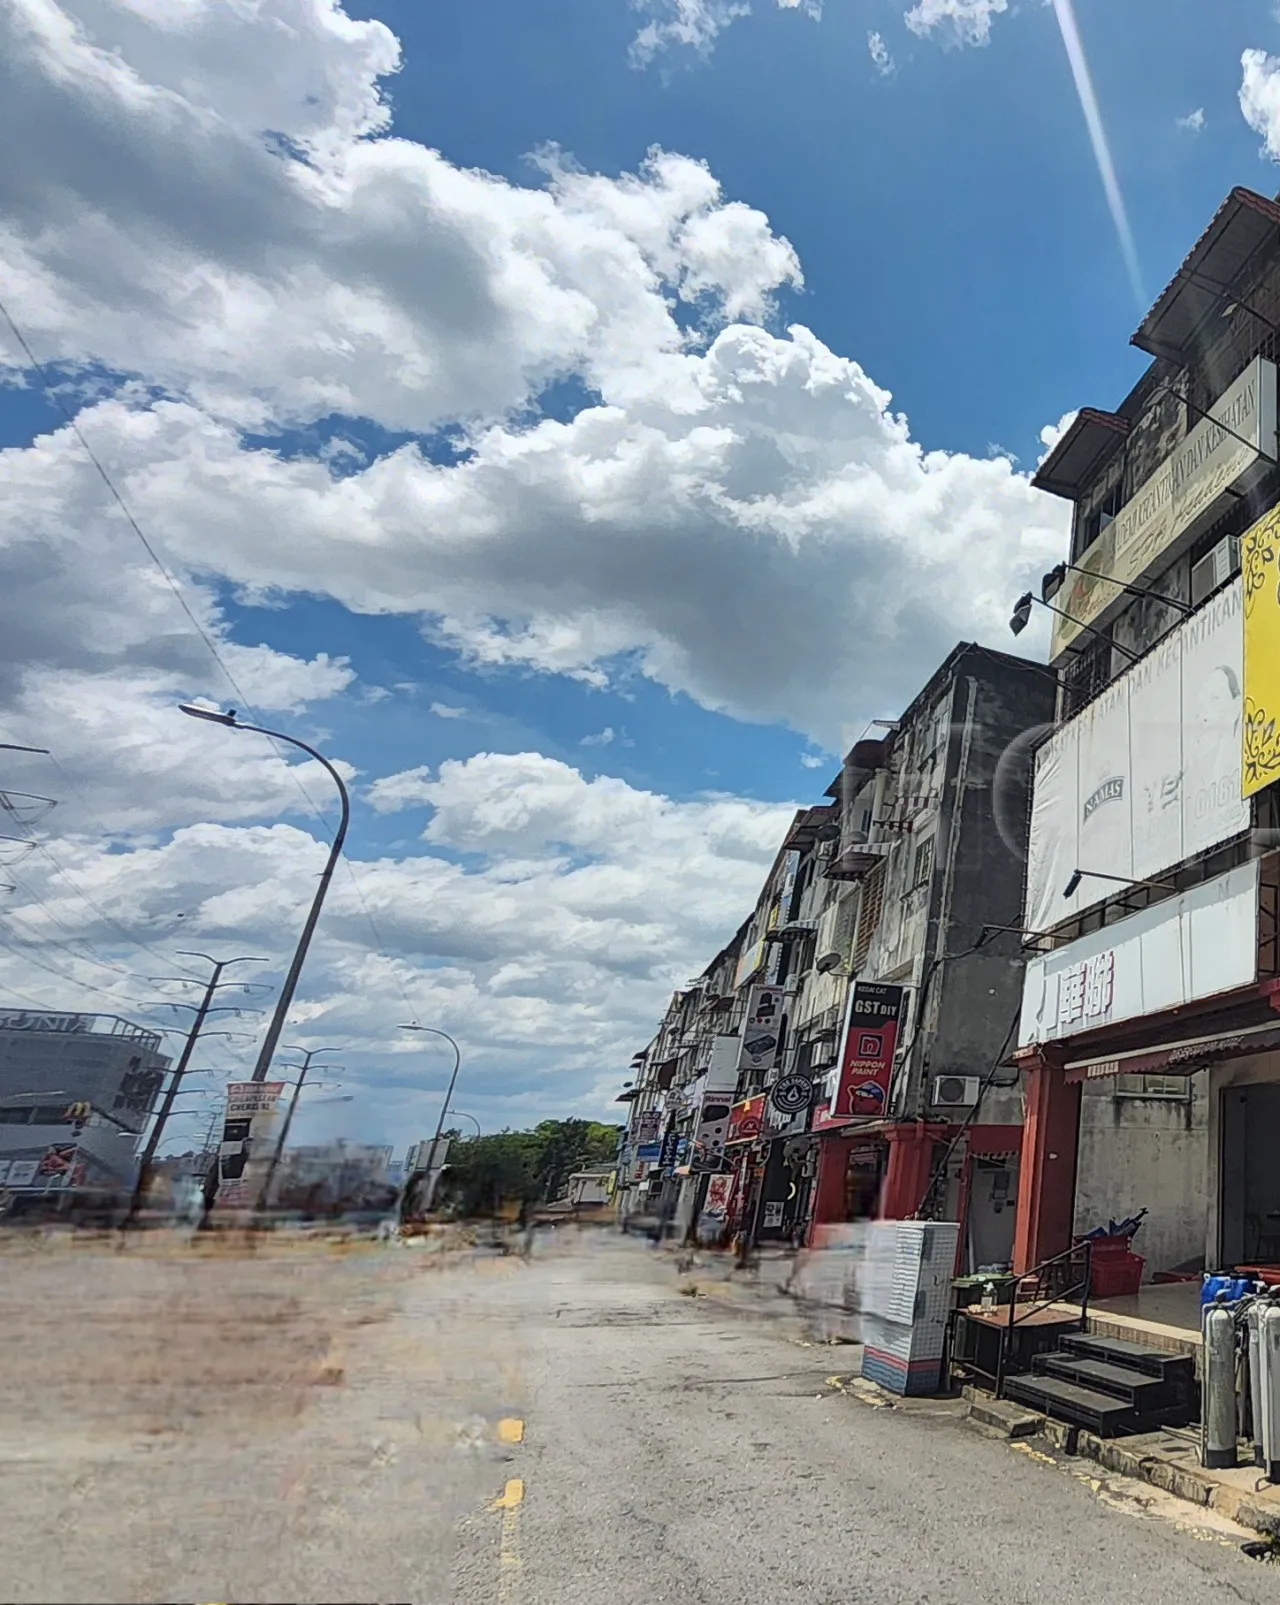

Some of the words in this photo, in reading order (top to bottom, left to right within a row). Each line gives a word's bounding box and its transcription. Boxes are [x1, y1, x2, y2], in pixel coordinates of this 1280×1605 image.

[855, 999, 880, 1015] GST
[880, 1005, 897, 1017] DIY
[850, 1060, 885, 1069] NIPPON
[851, 1068, 879, 1076] PAINT
